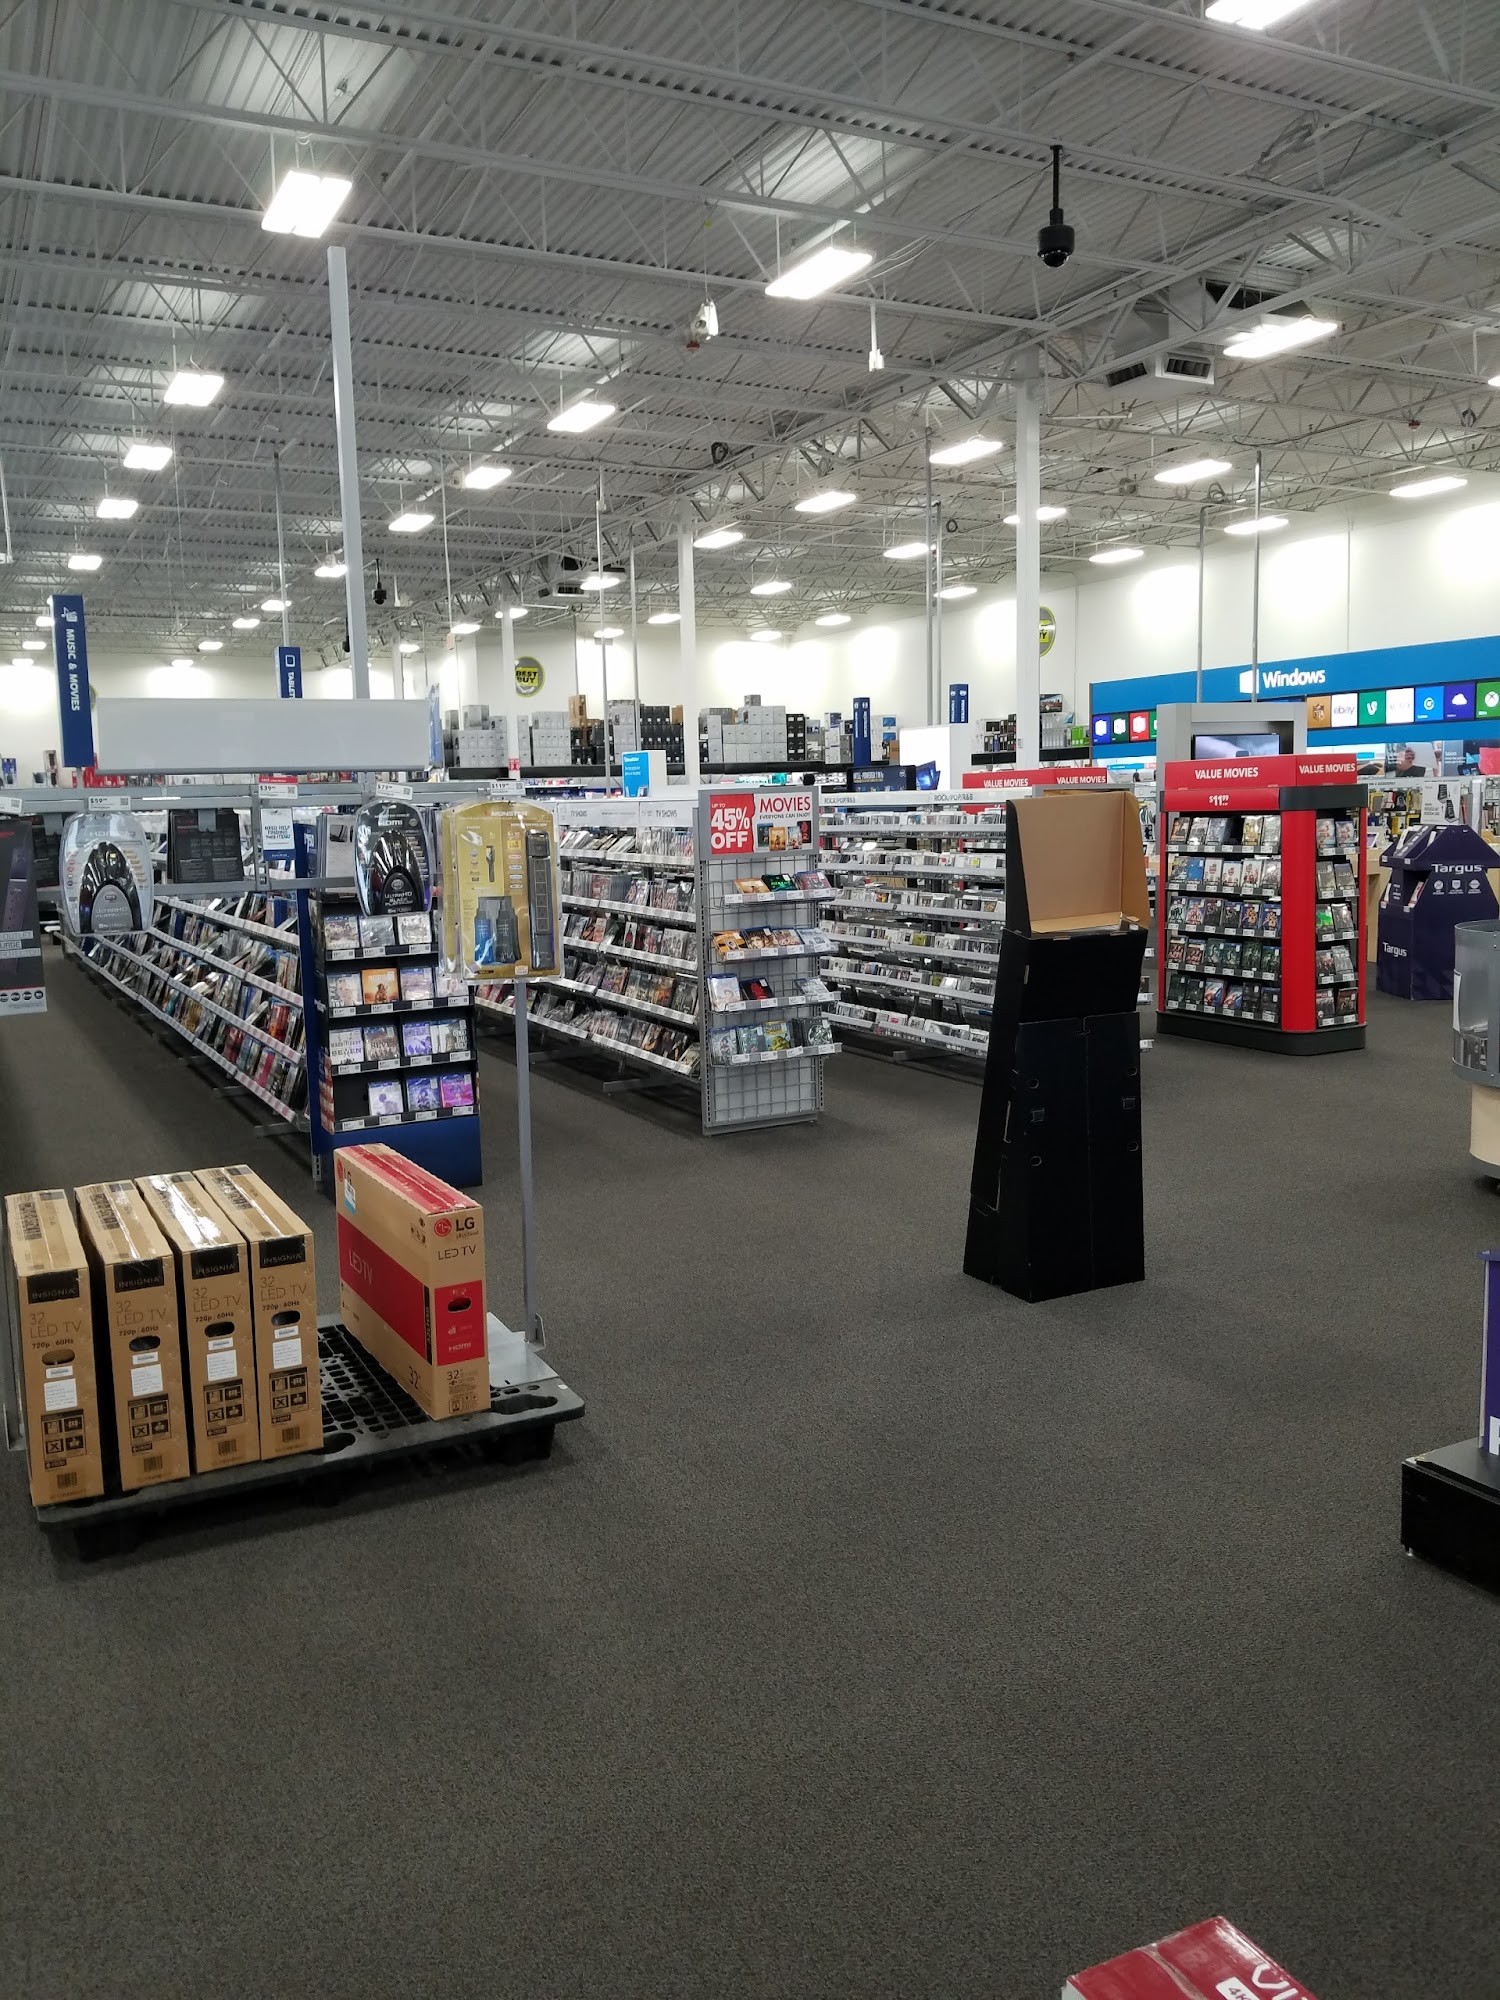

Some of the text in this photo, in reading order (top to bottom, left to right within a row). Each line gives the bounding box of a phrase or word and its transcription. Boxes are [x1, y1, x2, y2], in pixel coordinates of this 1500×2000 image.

[65, 628, 80, 711] MUSIC & MOVIES
[516, 676, 536, 684] BUY
[1262, 667, 1326, 689] Windows
[1333, 704, 1355, 715] ebay
[1194, 766, 1259, 780] VALUE MOVIES
[1298, 762, 1356, 774] VALUE MOVIES
[983, 778, 1029, 788] VALUE MOVIES
[1056, 775, 1107, 785] VALUE MOVIES
[760, 796, 811, 813] MOVIES
[655, 809, 678, 818] TV SHOWS
[710, 806, 751, 831] 45%
[710, 830, 749, 850] OFF
[1431, 863, 1483, 875] Targus
[1382, 941, 1408, 958] Targus
[456, 1216, 475, 1231] LG
[262, 1253, 302, 1265] INSIGNIA
[437, 1244, 478, 1261] LED TV
[194, 1263, 237, 1276] INSIGNIA
[348, 1251, 374, 1286] LED TV
[118, 1276, 161, 1289] INSIGNIA
[259, 1275, 276, 1289] 32
[31, 1287, 76, 1300] INSIGNIA
[191, 1287, 208, 1300] 32
[259, 1282, 308, 1302] LED TV
[115, 1300, 132, 1314] 32
[192, 1293, 243, 1314] LED TV
[261, 1300, 301, 1312] 720p 60Hz
[29, 1312, 46, 1326] 32
[115, 1307, 168, 1328] LED TV
[194, 1311, 235, 1324] 720p 60Hz
[29, 1319, 83, 1340] LED TV
[118, 1325, 160, 1338] 720p 60Hz
[31, 1338, 75, 1351] 720p 60Hz
